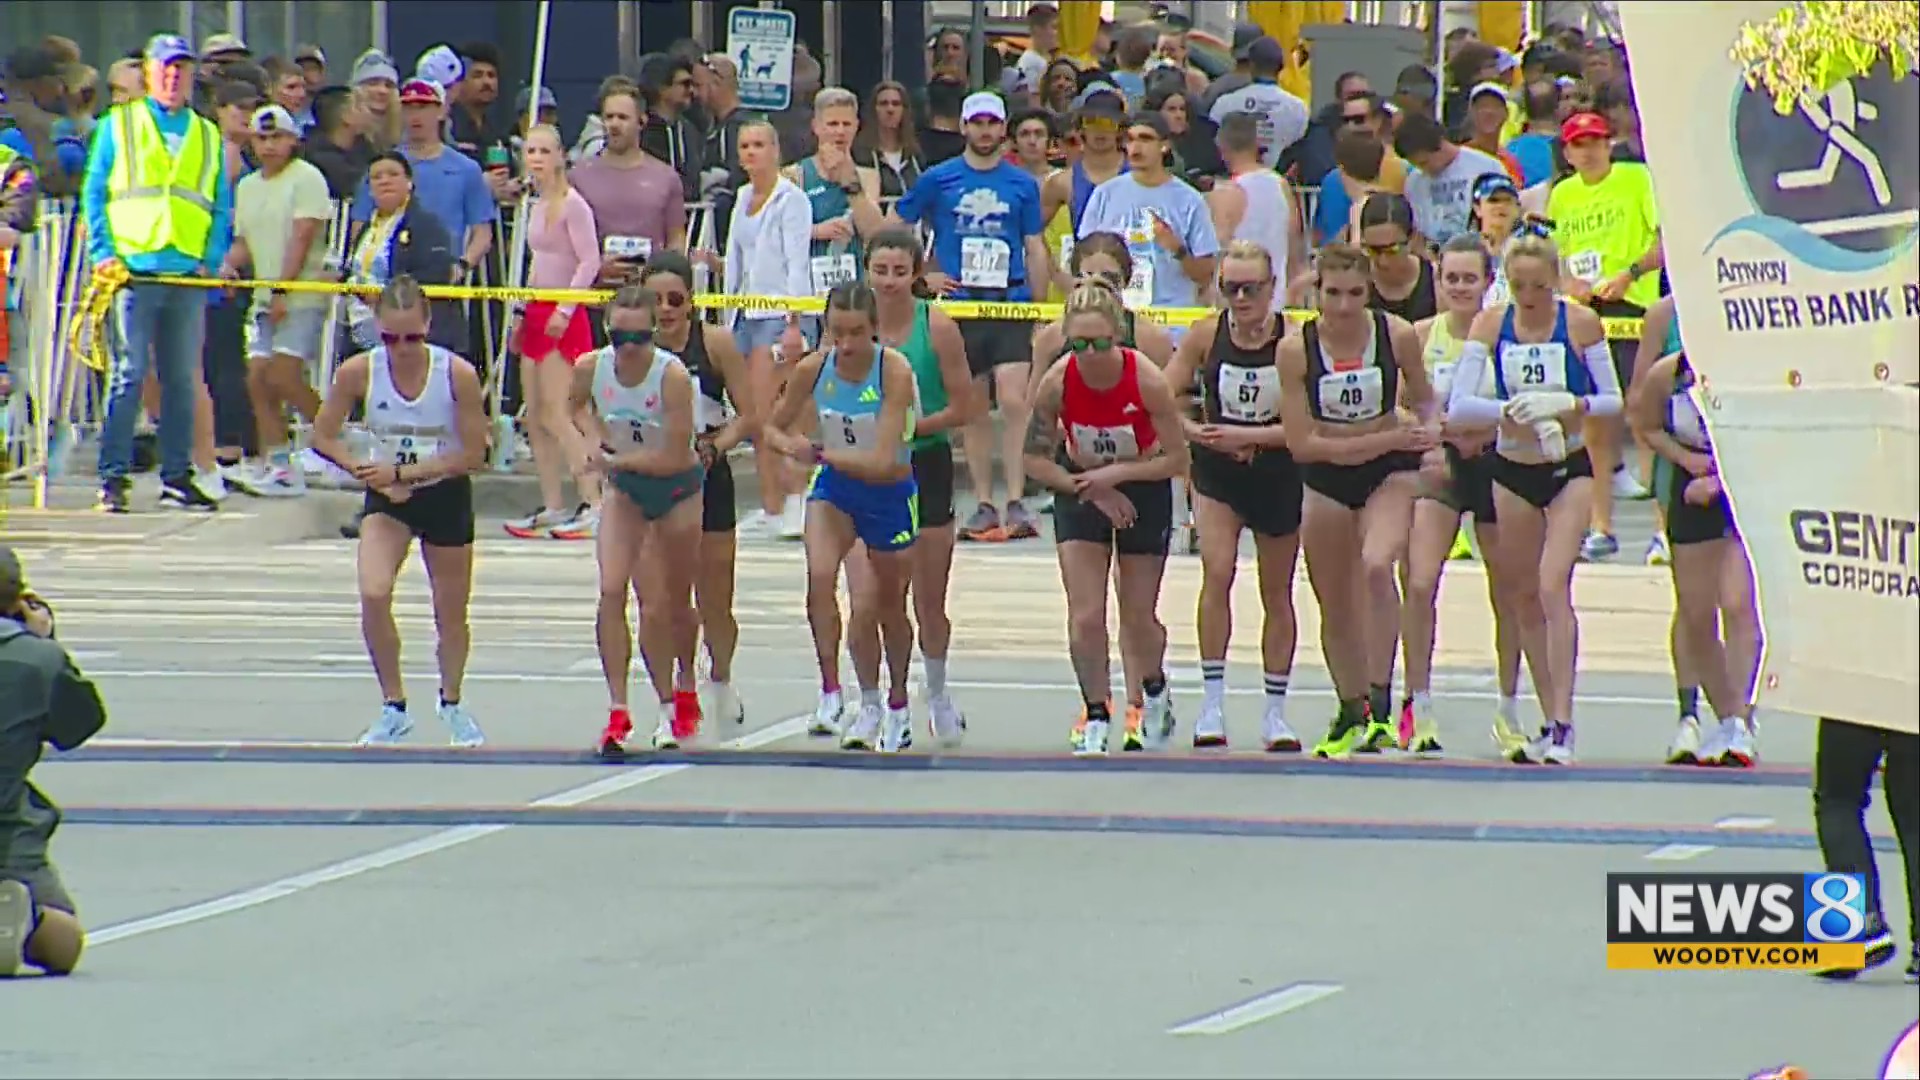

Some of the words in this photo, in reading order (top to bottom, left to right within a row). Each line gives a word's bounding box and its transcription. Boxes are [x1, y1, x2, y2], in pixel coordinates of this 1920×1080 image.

[1717, 256, 1787, 285] Amway
[978, 303, 1042, 319] CAUTION
[1723, 295, 1802, 331] RIVER
[1806, 286, 1893, 327] BANK
[1522, 364, 1545, 385] 29
[1238, 384, 1260, 403] 57
[1339, 387, 1363, 405] 48
[843, 427, 856, 444] 5
[1789, 510, 1915, 565] GENT
